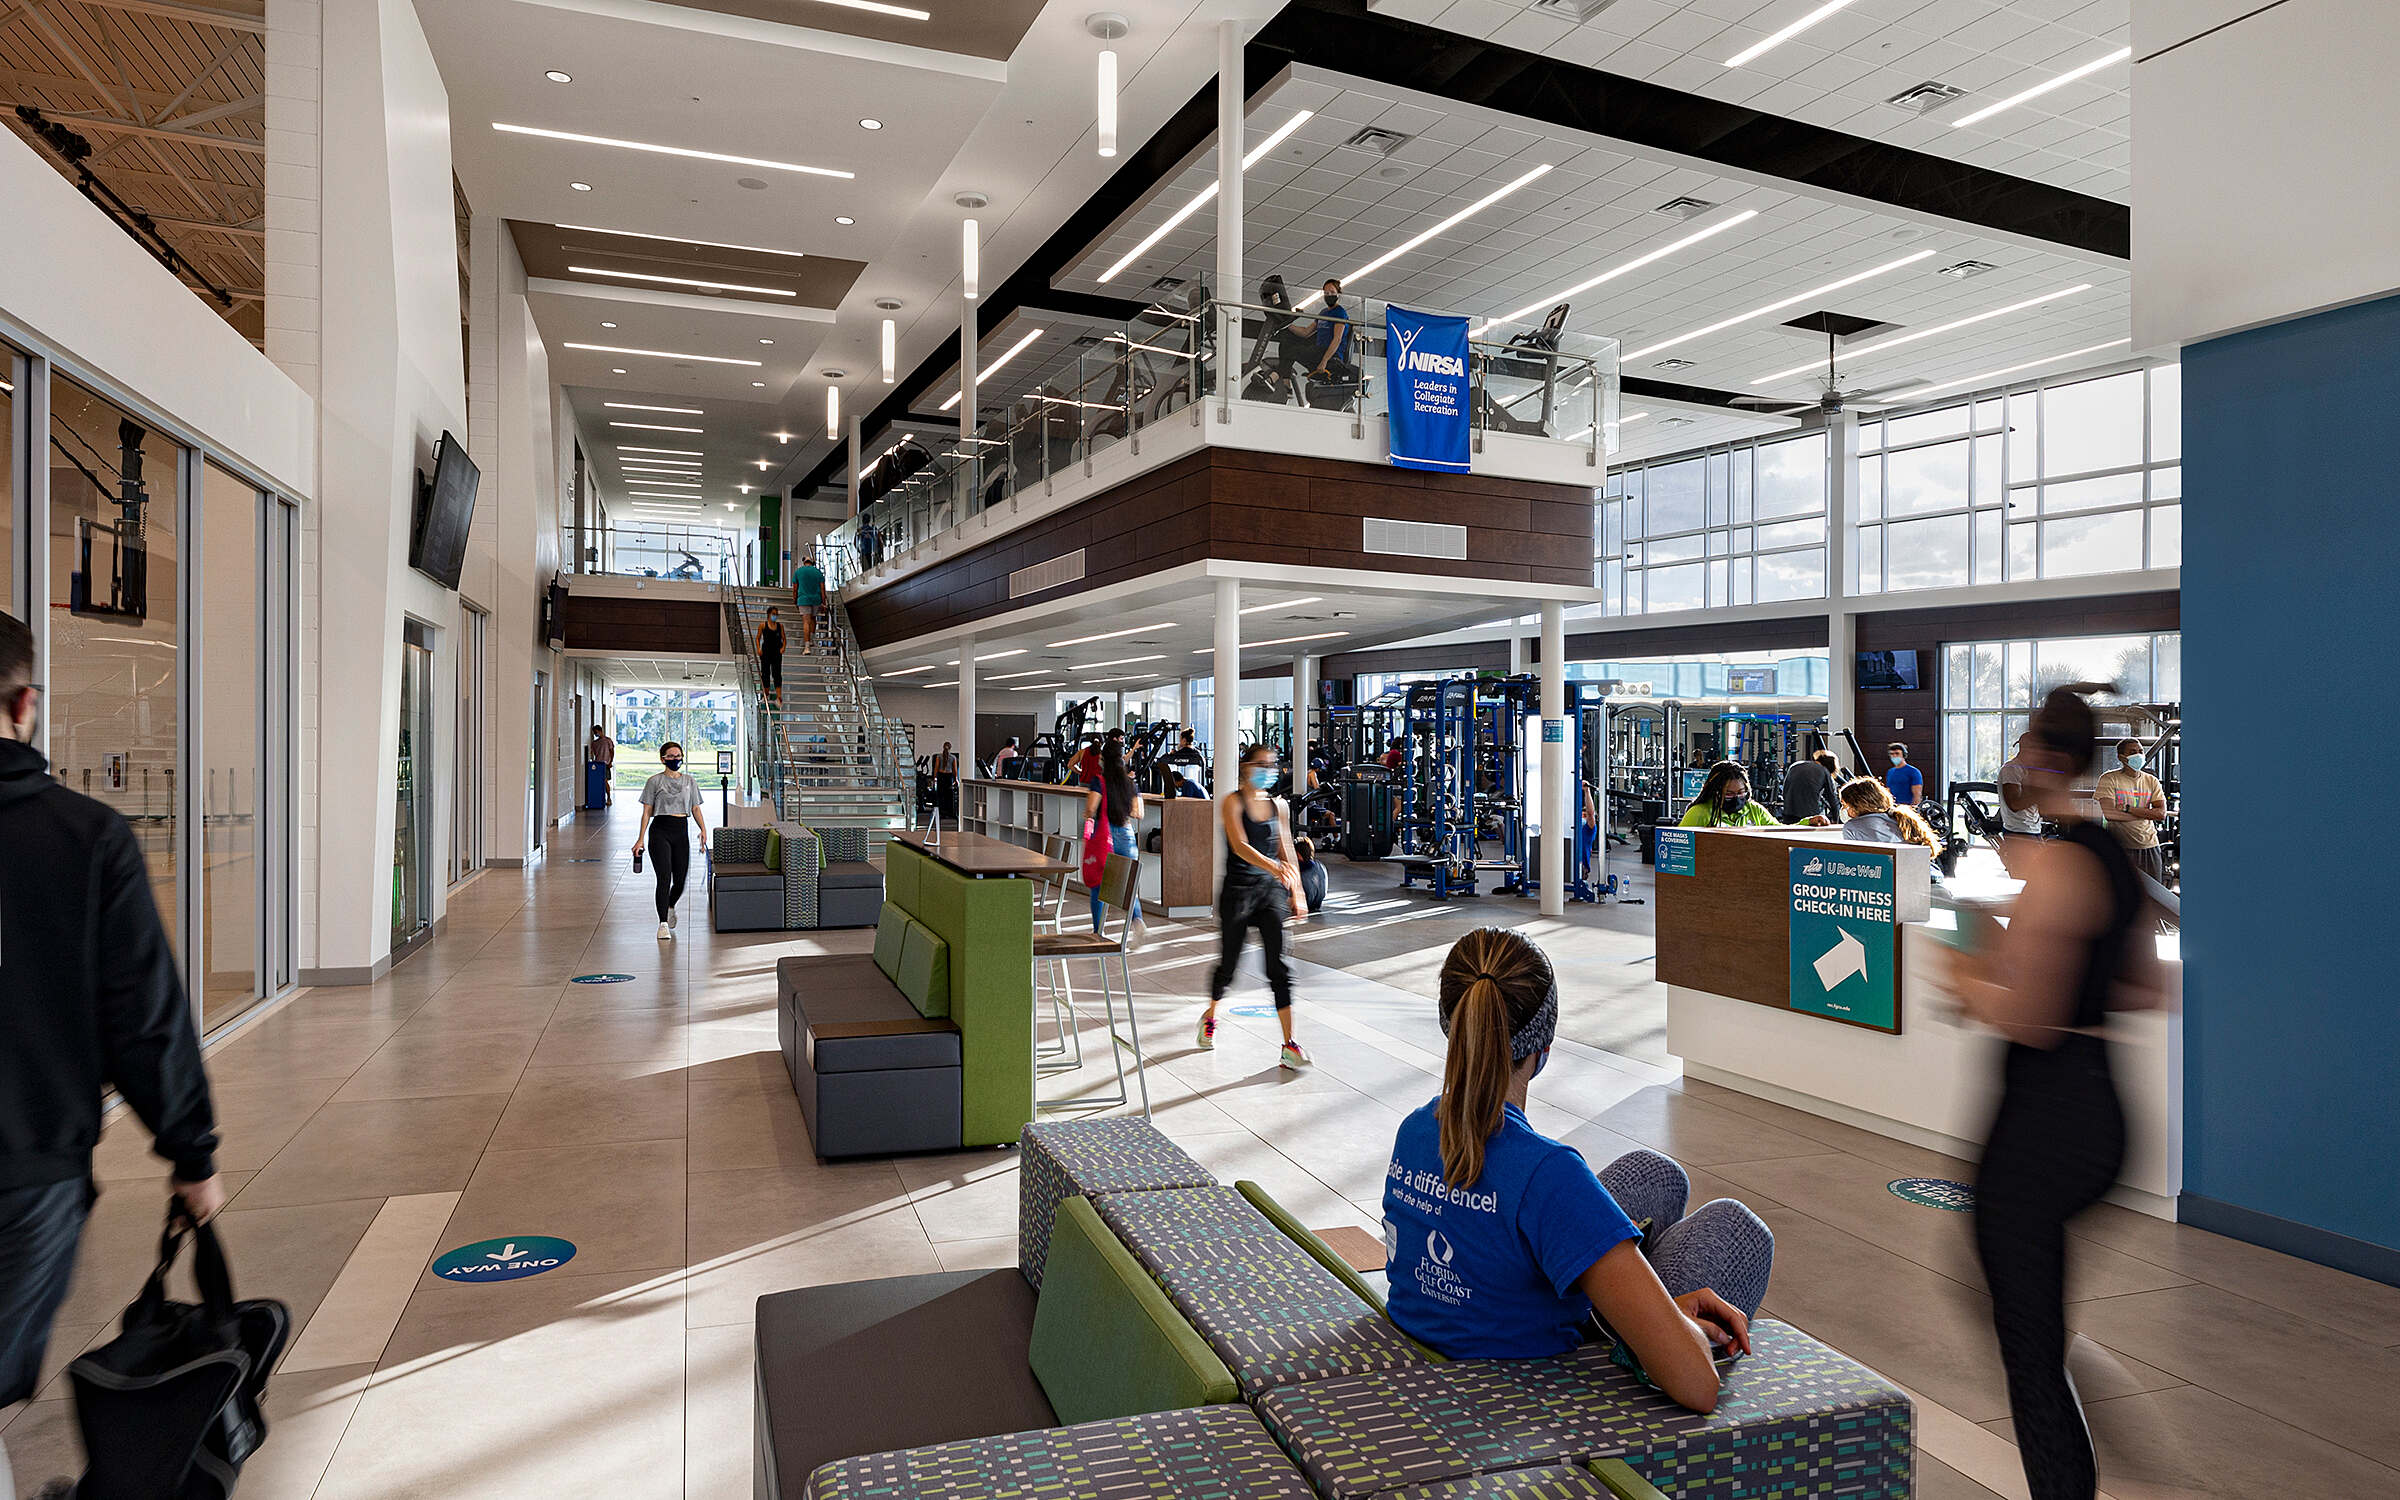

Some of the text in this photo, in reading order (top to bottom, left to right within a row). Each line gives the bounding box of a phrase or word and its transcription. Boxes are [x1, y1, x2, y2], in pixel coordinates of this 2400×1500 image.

[1408, 351, 1464, 377] NIRSA
[1414, 379, 1458, 394] Leaders in
[1414, 390, 1455, 405] Collegiate
[1414, 401, 1459, 416] Recreation
[1827, 862, 1836, 875] U
[1836, 863, 1857, 877] Rec
[1857, 864, 1882, 879] Well
[1792, 883, 1892, 907] GROUP FITNESS
[1793, 898, 1891, 923] CHECK-IN HERE
[1392, 1187, 1404, 1200] with
[1403, 1192, 1415, 1206] the
[1416, 1196, 1433, 1215] help
[1404, 1169, 1413, 1187] a
[1414, 1169, 1497, 1214] difference!
[1906, 1187, 1966, 1207] HERE
[444, 1258, 559, 1277] ONE WAY
[1421, 1256, 1461, 1284] FLORIDA
[1414, 1266, 1473, 1299] GULF COAST
[1421, 1282, 1461, 1306] UNIVERSITY
